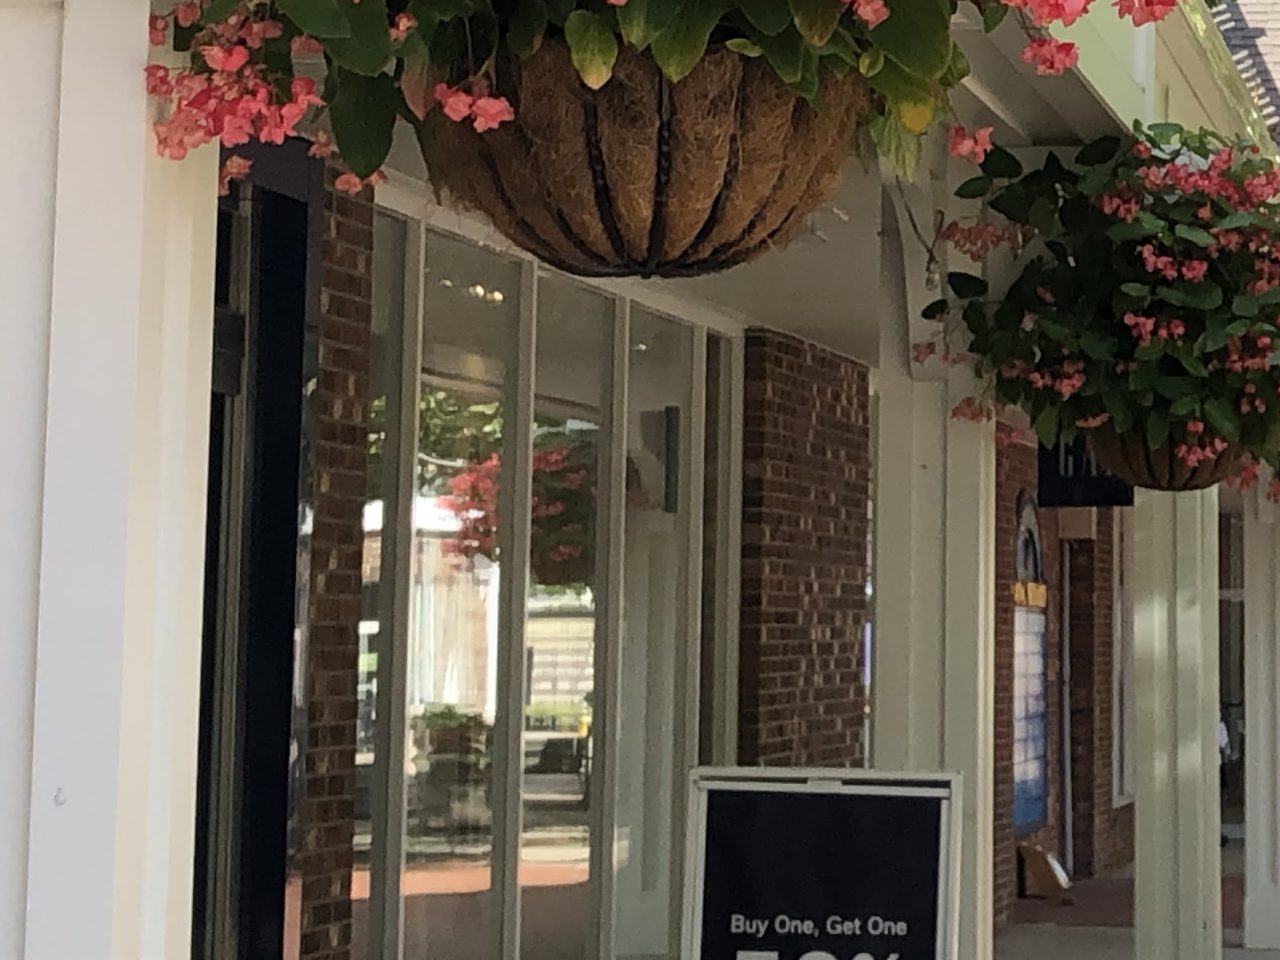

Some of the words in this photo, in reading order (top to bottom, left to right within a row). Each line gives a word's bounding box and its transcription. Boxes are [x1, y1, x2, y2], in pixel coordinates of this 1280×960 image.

[730, 913, 769, 938] Buy
[774, 914, 820, 938] One,
[825, 915, 862, 936] Get
[867, 916, 908, 936] One
